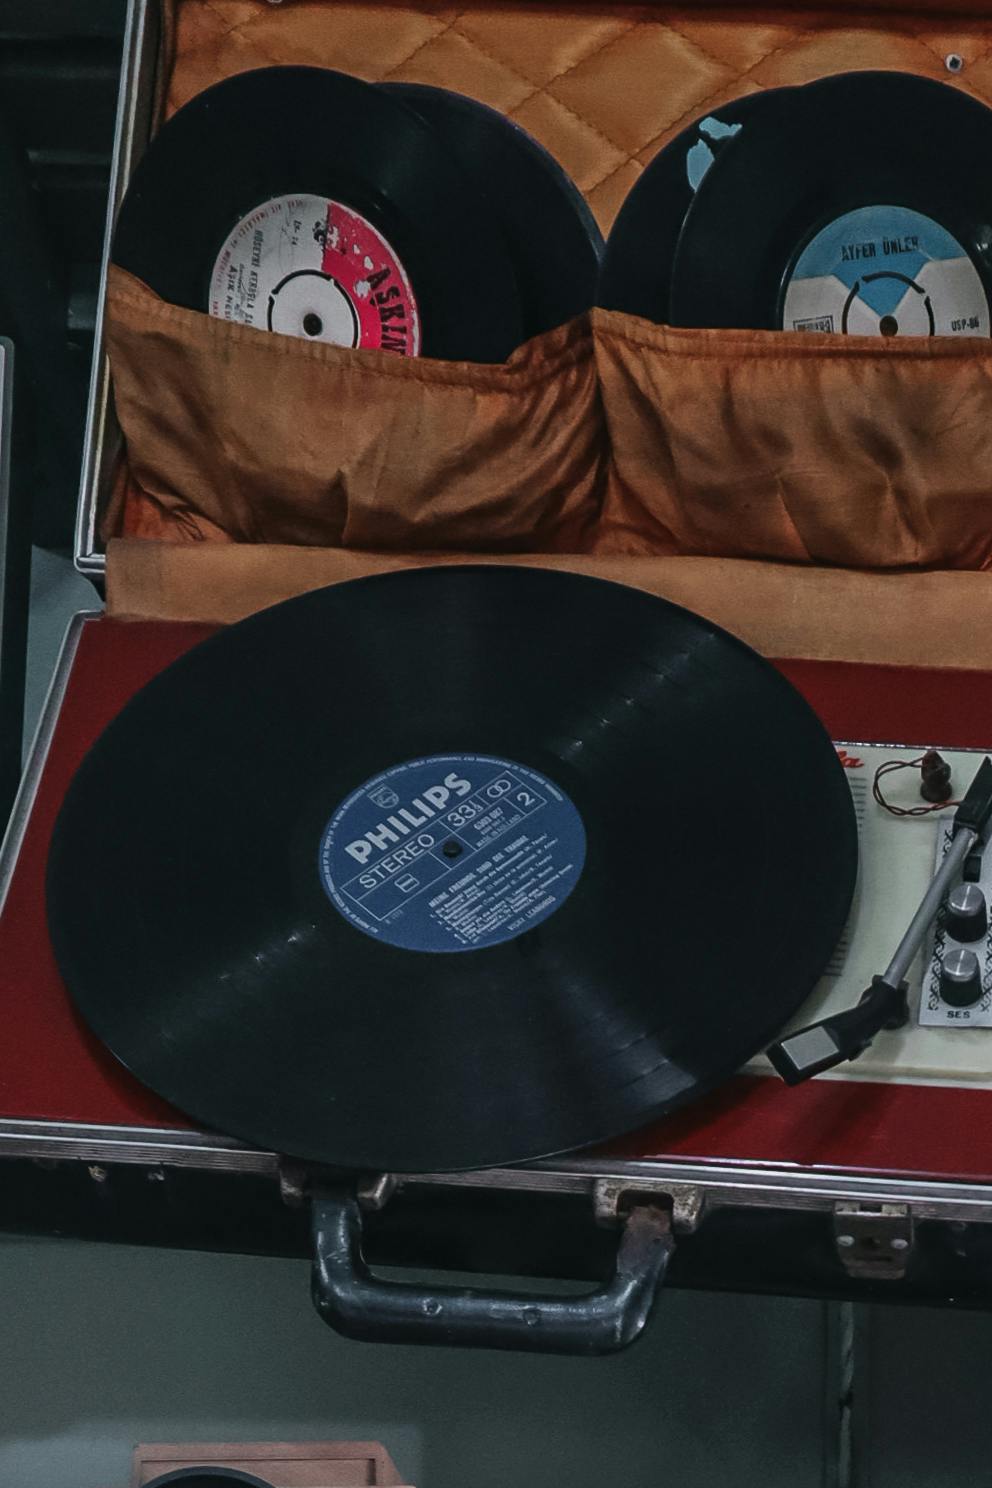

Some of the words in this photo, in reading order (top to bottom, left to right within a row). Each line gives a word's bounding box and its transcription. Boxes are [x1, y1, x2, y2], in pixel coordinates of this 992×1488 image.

[841, 244, 877, 262] AYFER
[516, 792, 536, 807] 2
[344, 771, 472, 865] PHILIPS
[359, 833, 435, 889] STEREO
[947, 1010, 971, 1020] SES
